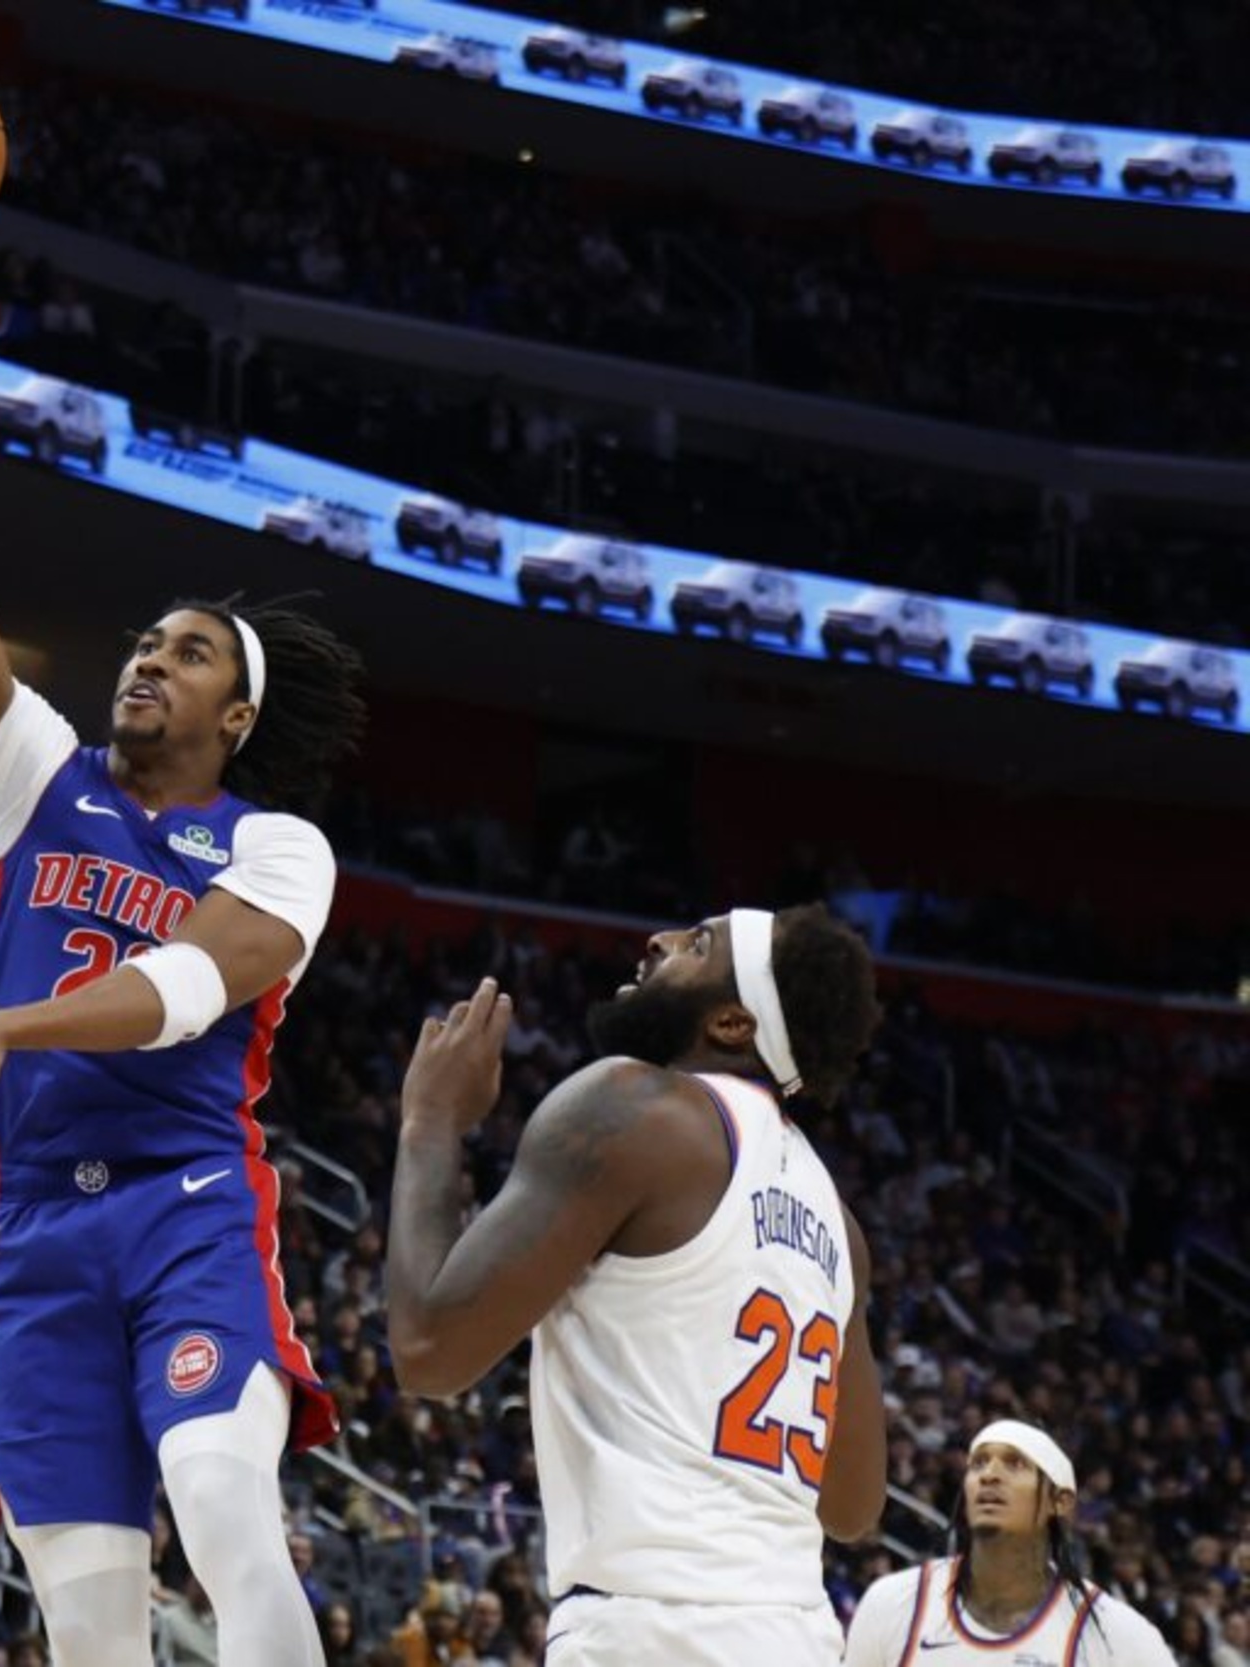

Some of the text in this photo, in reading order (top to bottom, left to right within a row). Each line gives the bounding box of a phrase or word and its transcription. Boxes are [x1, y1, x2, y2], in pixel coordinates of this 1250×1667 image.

[29, 852, 196, 941] DETRO
[51, 927, 154, 1000] 2
[751, 1186, 839, 1290] ROBINSON
[713, 1288, 840, 1492] 23
